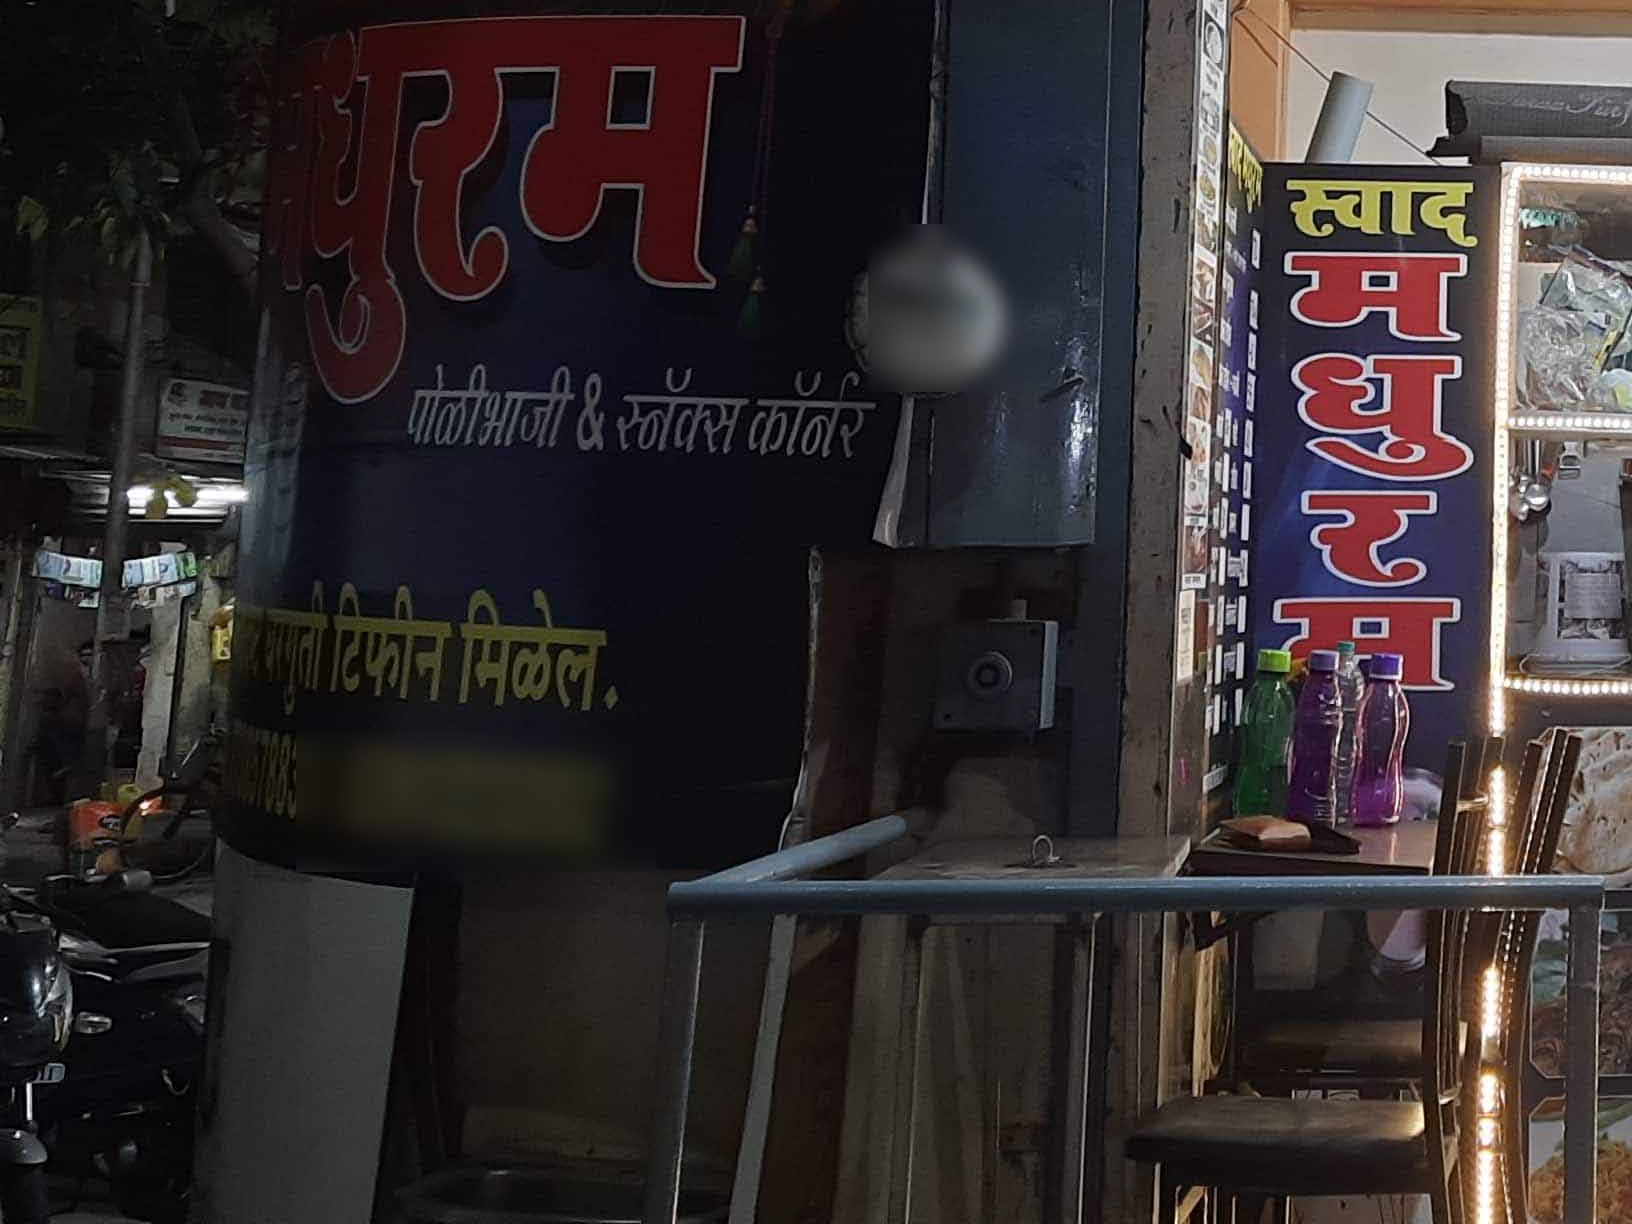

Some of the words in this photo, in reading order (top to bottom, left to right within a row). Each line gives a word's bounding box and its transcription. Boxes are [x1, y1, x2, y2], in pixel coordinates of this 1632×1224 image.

[1286, 179, 1478, 248] स्वाद
[408, 364, 574, 450] पोळीभाजी
[576, 372, 605, 452] &
